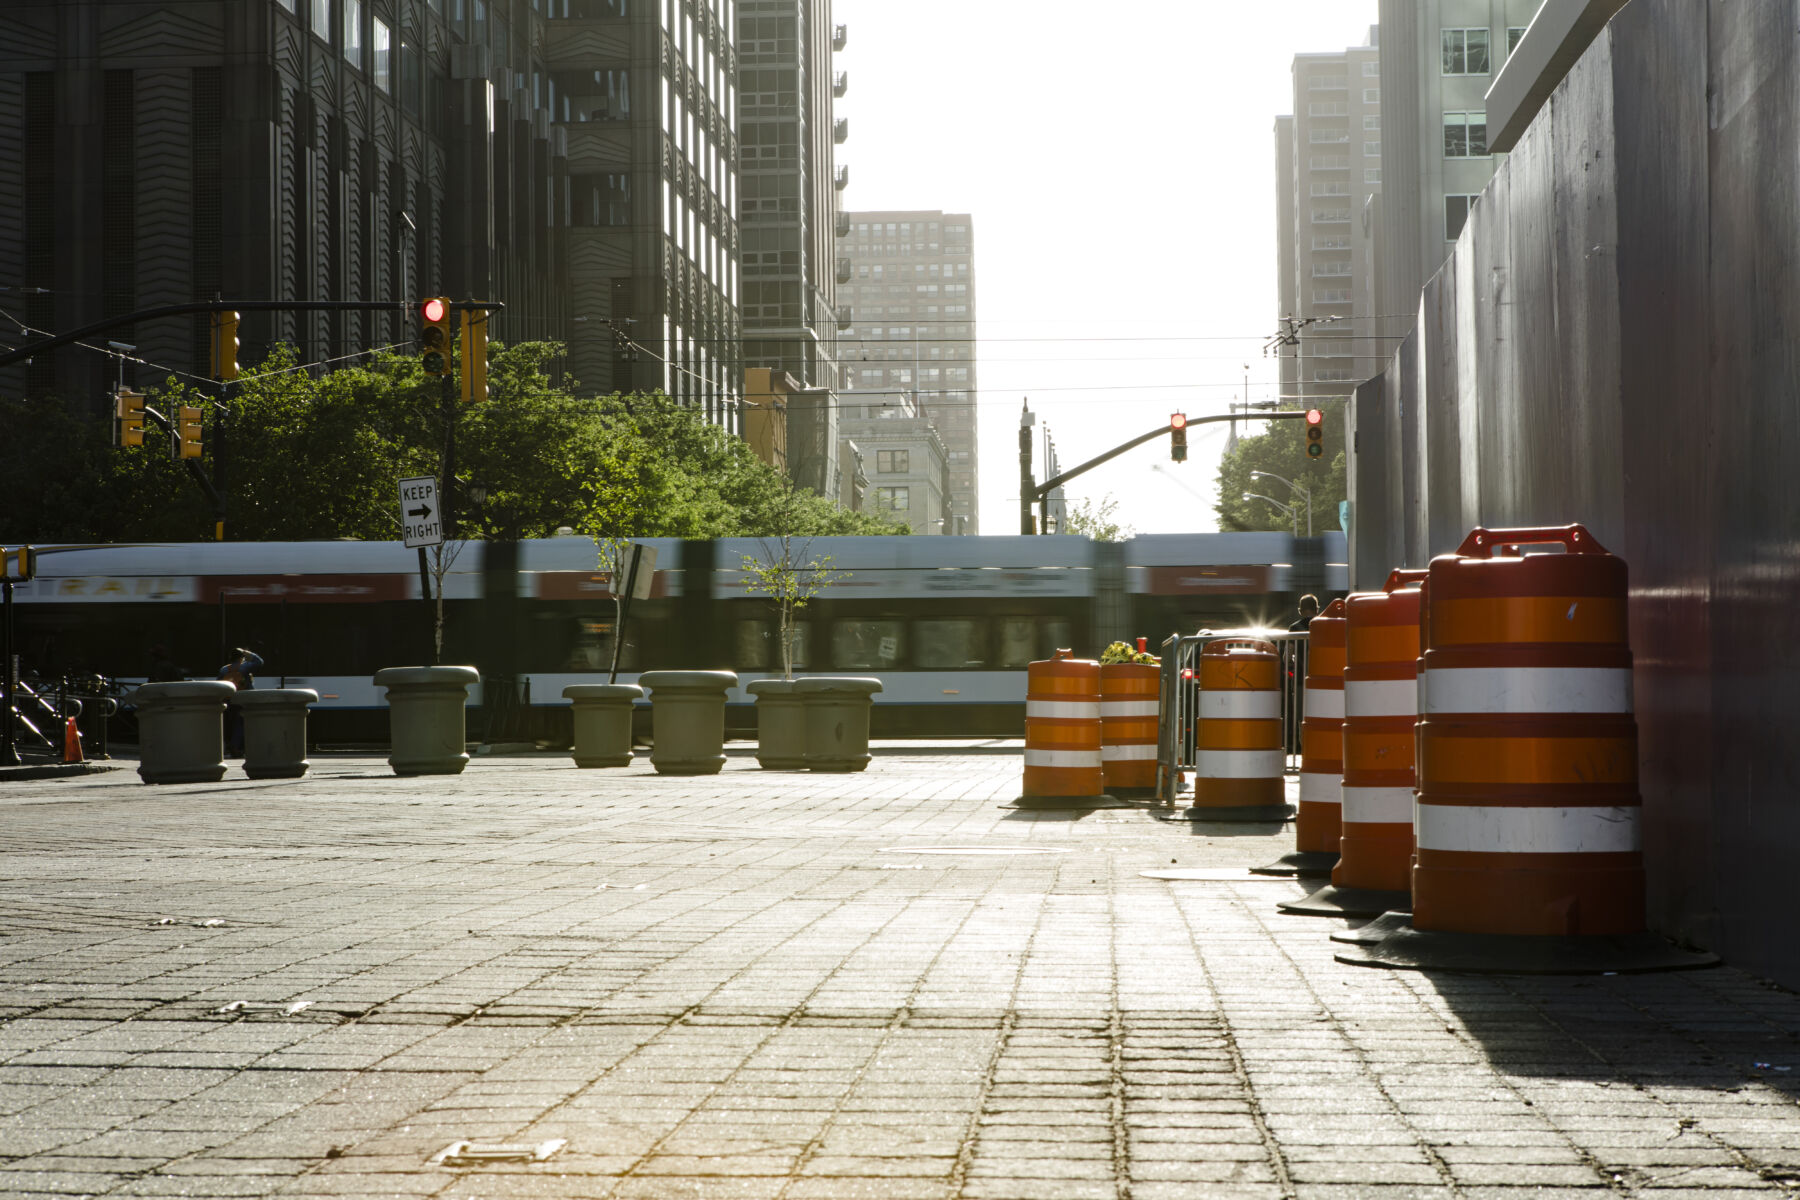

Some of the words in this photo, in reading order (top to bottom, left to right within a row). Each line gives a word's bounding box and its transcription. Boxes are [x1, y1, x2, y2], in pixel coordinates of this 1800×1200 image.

[403, 485, 433, 501] KEEP
[405, 522, 439, 539] RIGHT
[58, 578, 182, 596] RAIL
